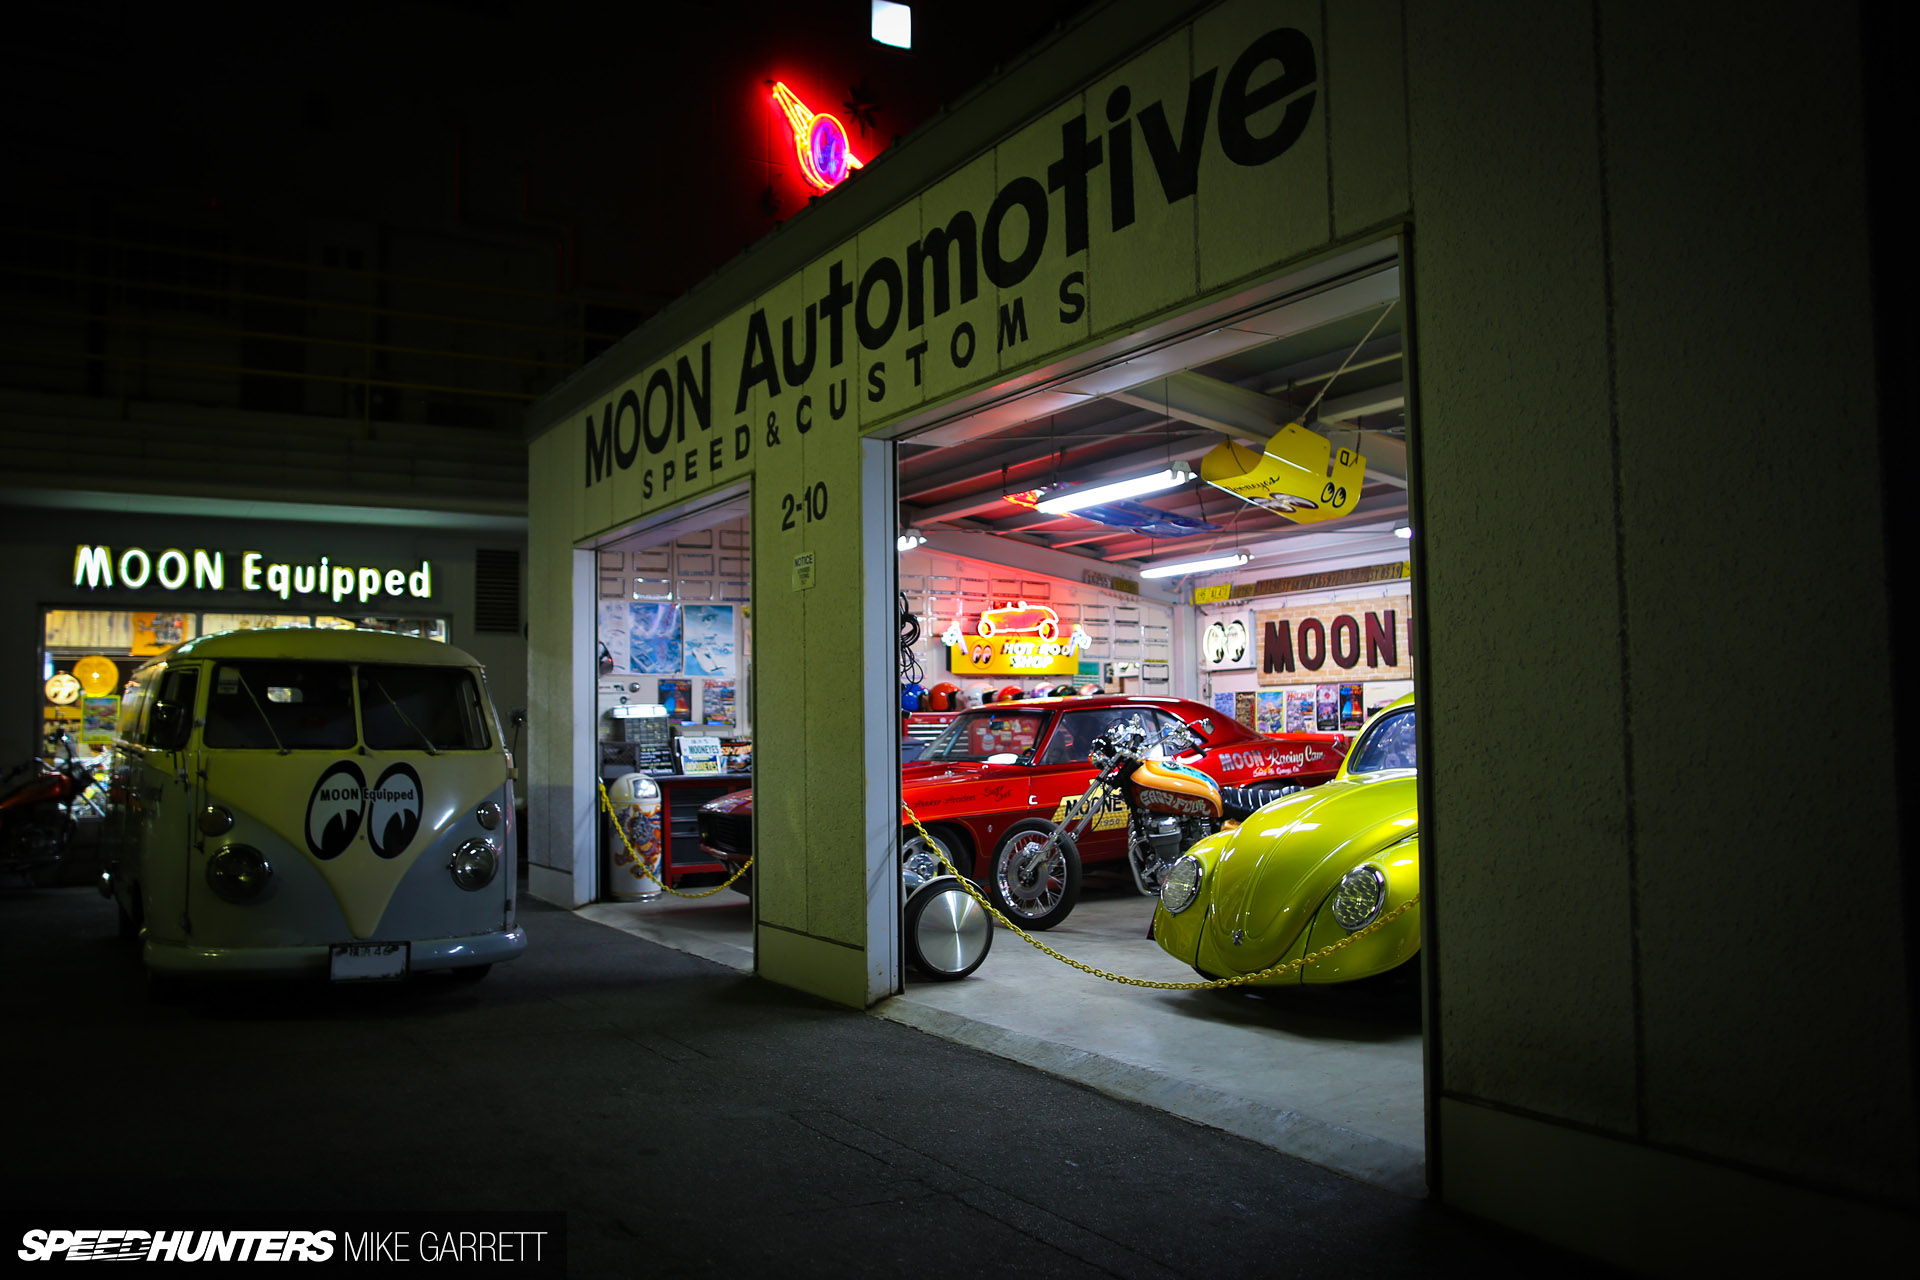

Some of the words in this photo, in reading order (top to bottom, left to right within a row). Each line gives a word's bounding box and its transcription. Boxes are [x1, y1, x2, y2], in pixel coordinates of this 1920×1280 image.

[586, 342, 711, 488] MOON
[735, 27, 1317, 415] Automotive
[643, 424, 750, 499] SPEED
[796, 271, 1086, 434] CUSTOMS
[782, 481, 828, 531] 2-10
[73, 544, 224, 590] MOON
[242, 550, 432, 603] Equipped
[1001, 642, 1035, 655] HOT
[1010, 655, 1054, 668] SHOP
[1263, 609, 1397, 674] MOON
[1219, 749, 1265, 772] MOON
[1264, 746, 1304, 769] Racing
[320, 788, 359, 801] MOON
[363, 787, 414, 803] Equipped
